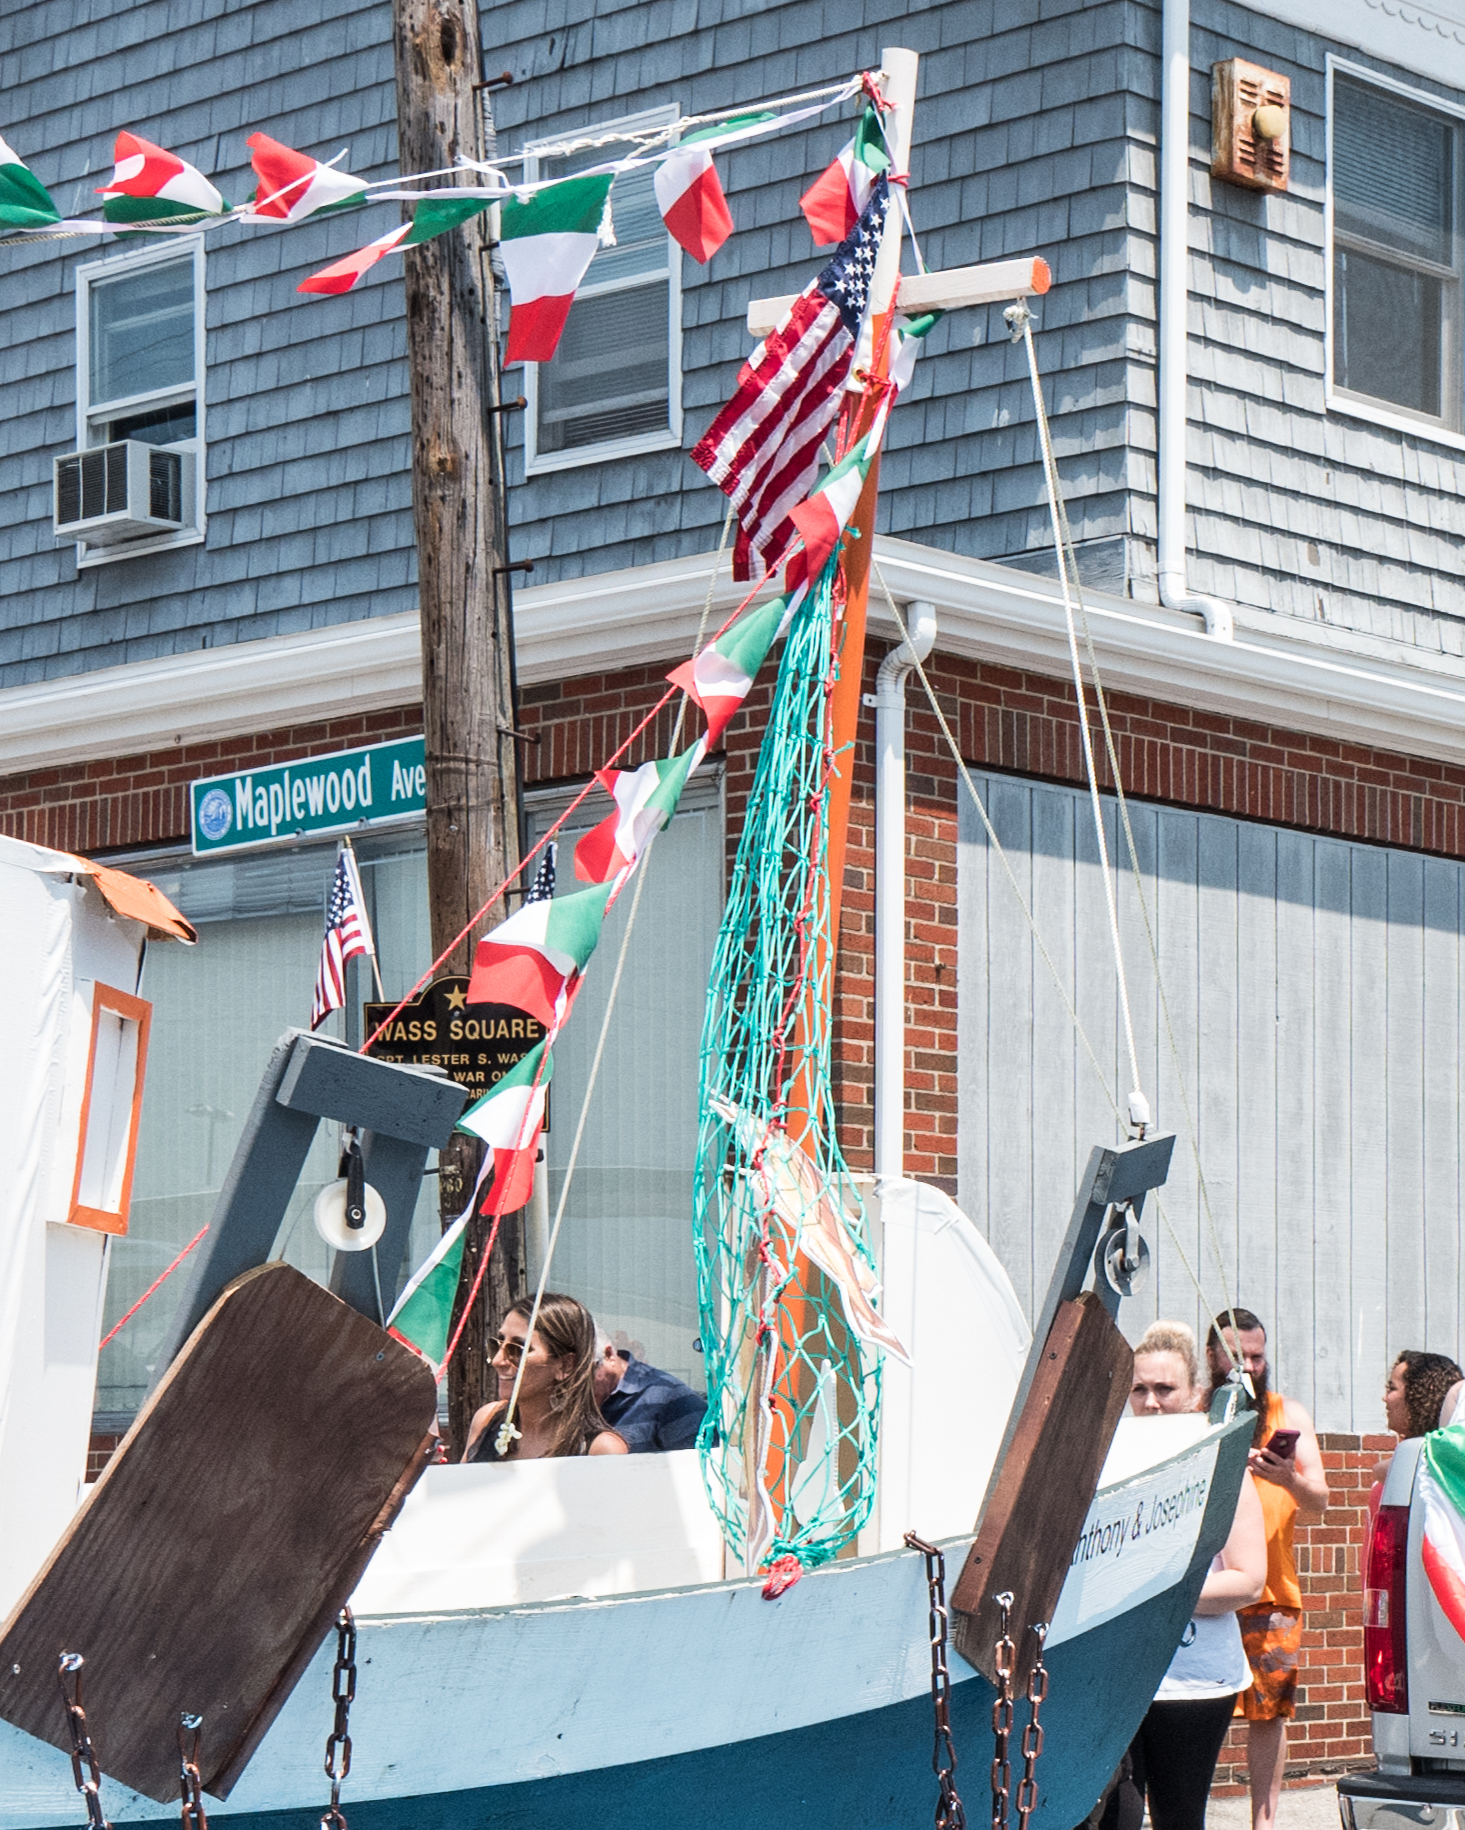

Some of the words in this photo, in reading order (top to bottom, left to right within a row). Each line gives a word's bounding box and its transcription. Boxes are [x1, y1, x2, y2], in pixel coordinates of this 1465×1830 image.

[235, 753, 373, 836] Maplewood
[391, 760, 426, 801] Ave
[375, 1020, 438, 1042] WASS
[450, 1018, 540, 1041] SQUARE
[477, 1053, 492, 1065] S.
[454, 1071, 485, 1082] WAR
[1071, 1517, 1131, 1566] nthony
[1131, 1501, 1144, 1540] &
[1146, 1478, 1206, 1534] Josephine
